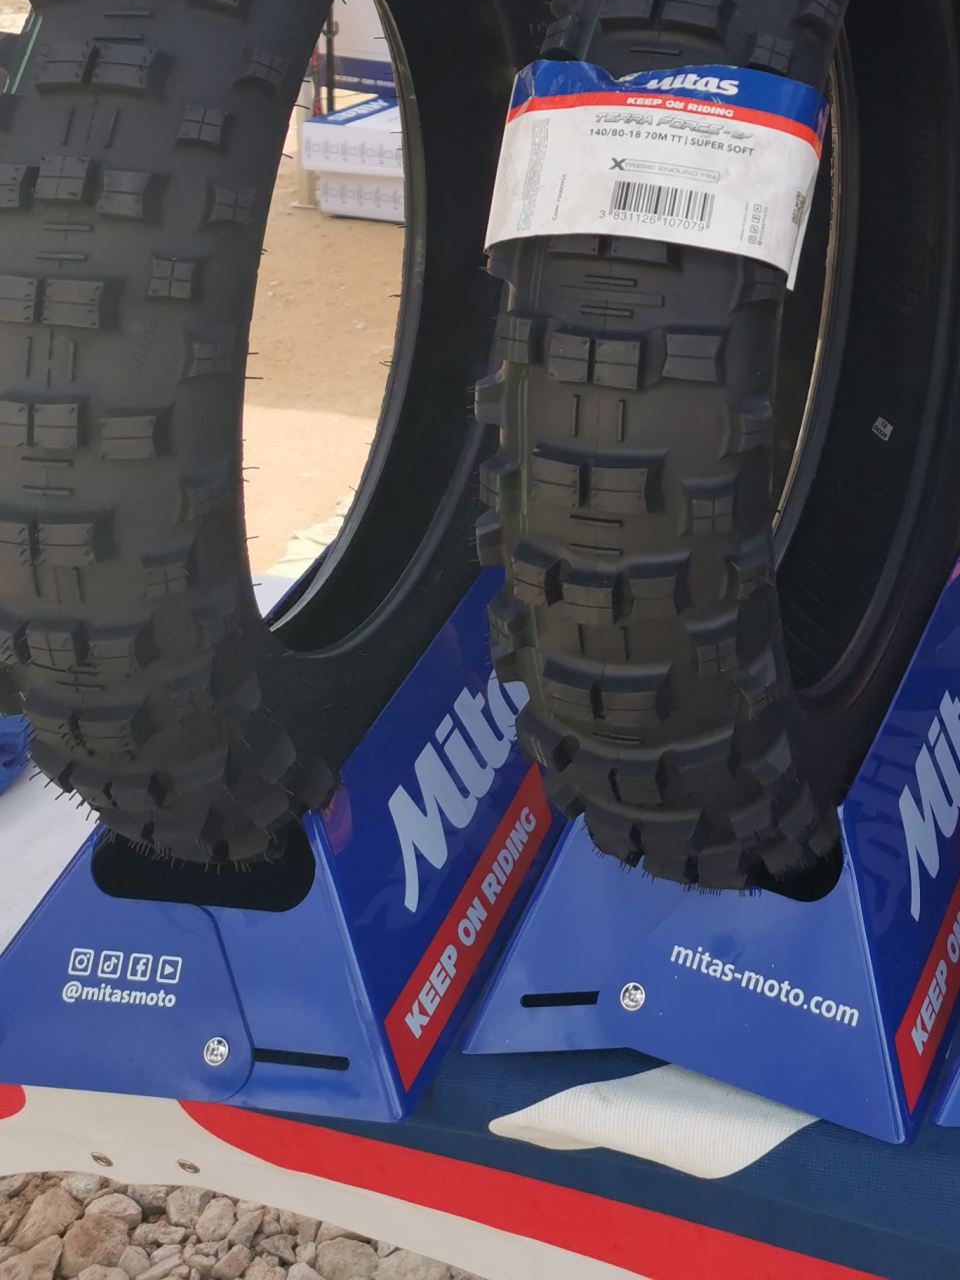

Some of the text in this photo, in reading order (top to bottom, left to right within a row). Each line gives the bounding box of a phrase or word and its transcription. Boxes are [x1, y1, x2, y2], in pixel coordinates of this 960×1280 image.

[589, 128, 642, 139] 140/80-18
[645, 129, 668, 142] 70M
[670, 135, 683, 144] TT
[690, 137, 724, 151] SUPER
[726, 144, 755, 156] SOFT
[626, 97, 734, 117] KEEP ON RIDING
[388, 668, 530, 913] Mita
[404, 806, 537, 1039] KEEP ON RIDING
[61, 980, 177, 1009] @mitasmoto
[669, 941, 860, 1027] mitas-moto.com
[910, 959, 949, 1056] KEEP
